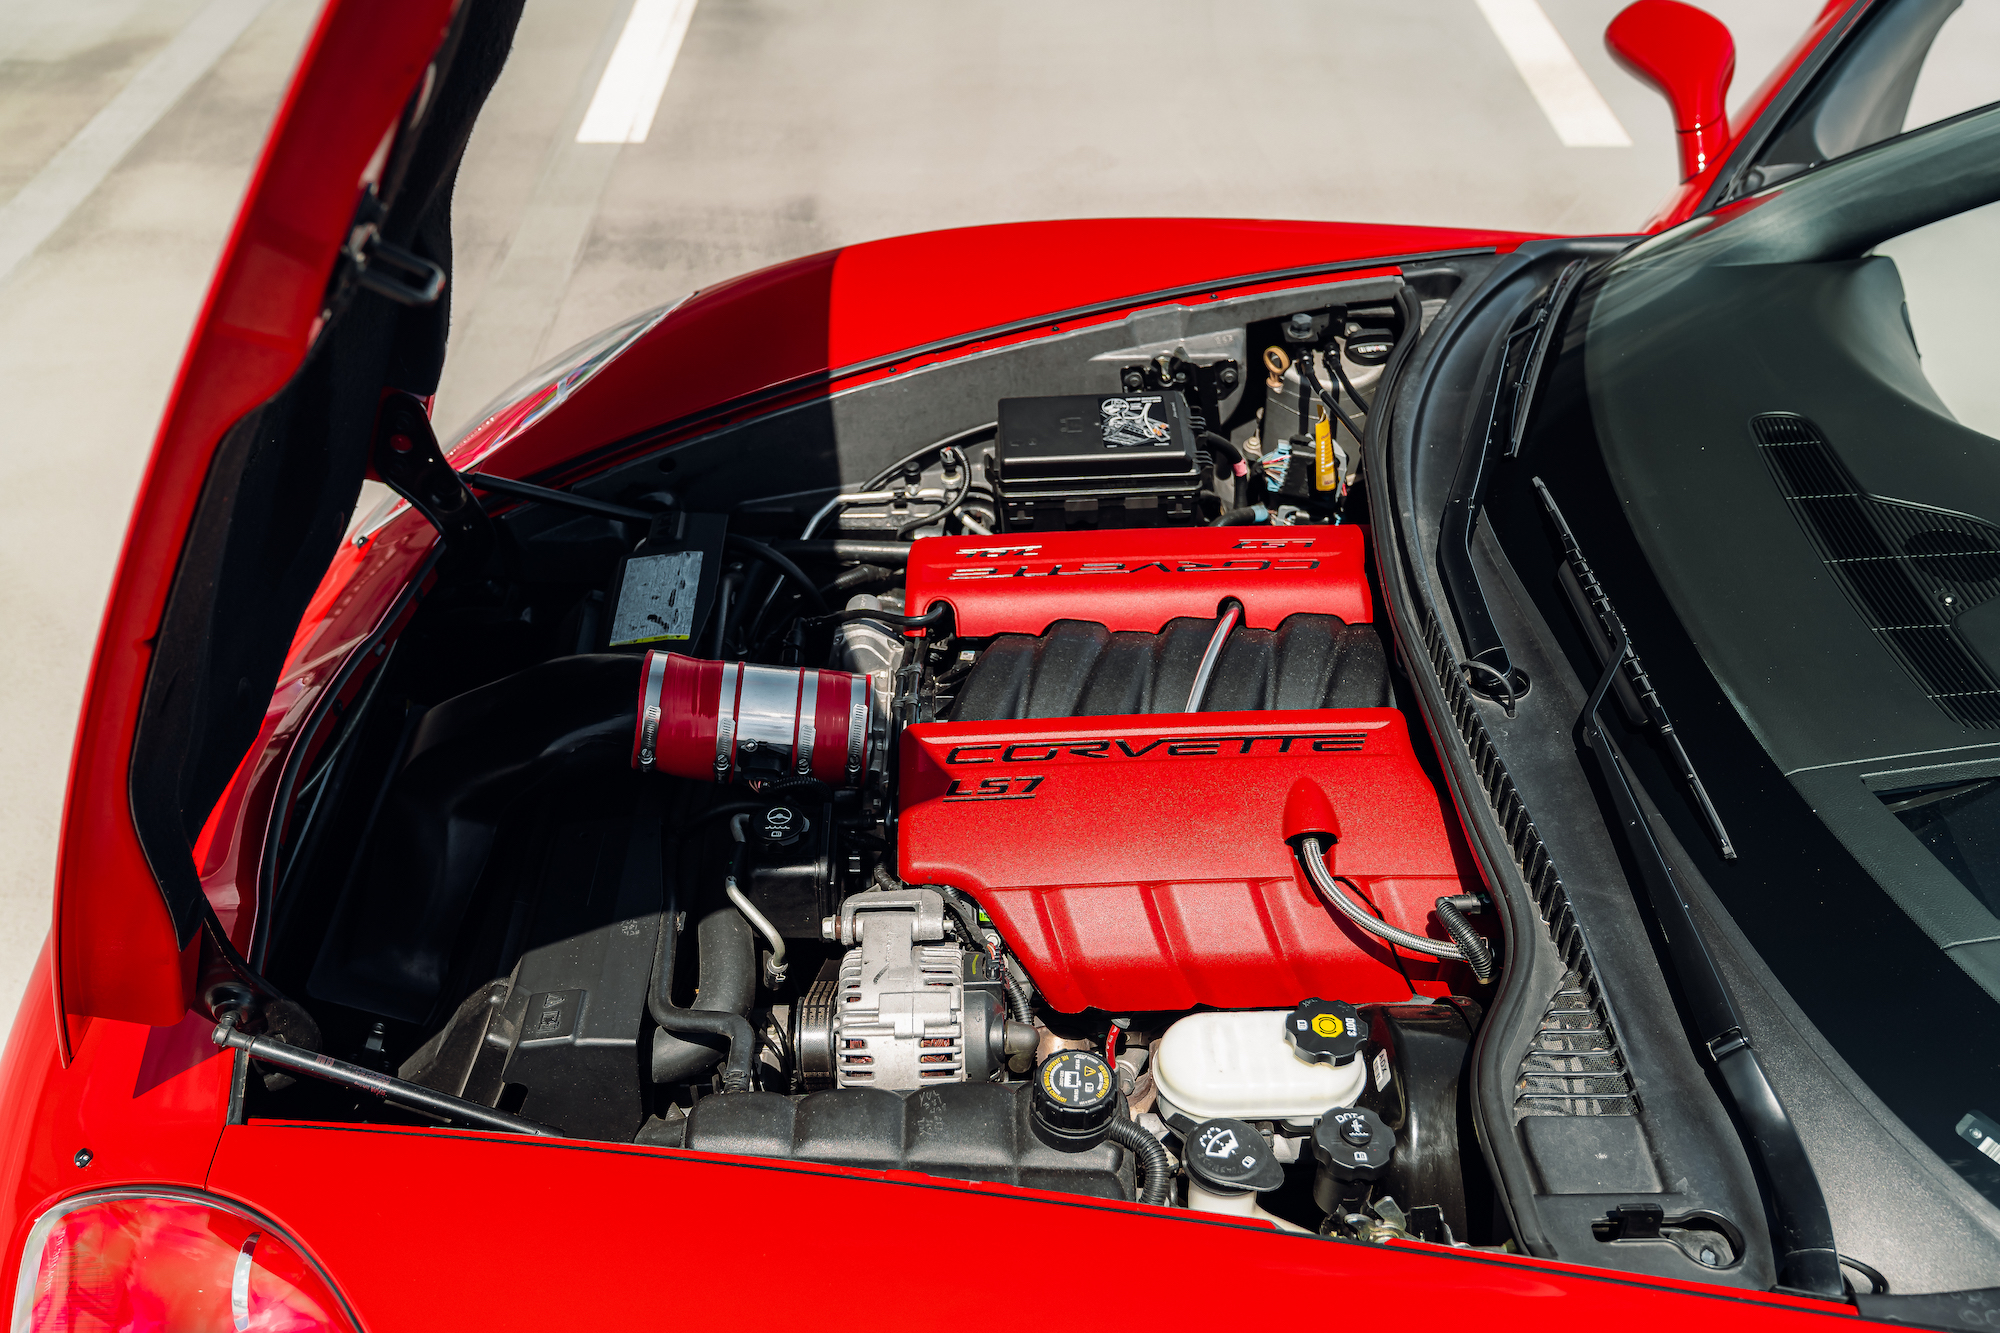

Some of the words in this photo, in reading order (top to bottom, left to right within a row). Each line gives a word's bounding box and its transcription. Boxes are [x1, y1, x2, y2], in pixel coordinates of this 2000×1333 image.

[948, 558, 1321, 580] CORVETTE
[945, 732, 1368, 765] CORVETTE
[945, 775, 1045, 799] LS7
[1345, 1017, 1358, 1037] DOT3
[1378, 1053, 1387, 1074] ADX
